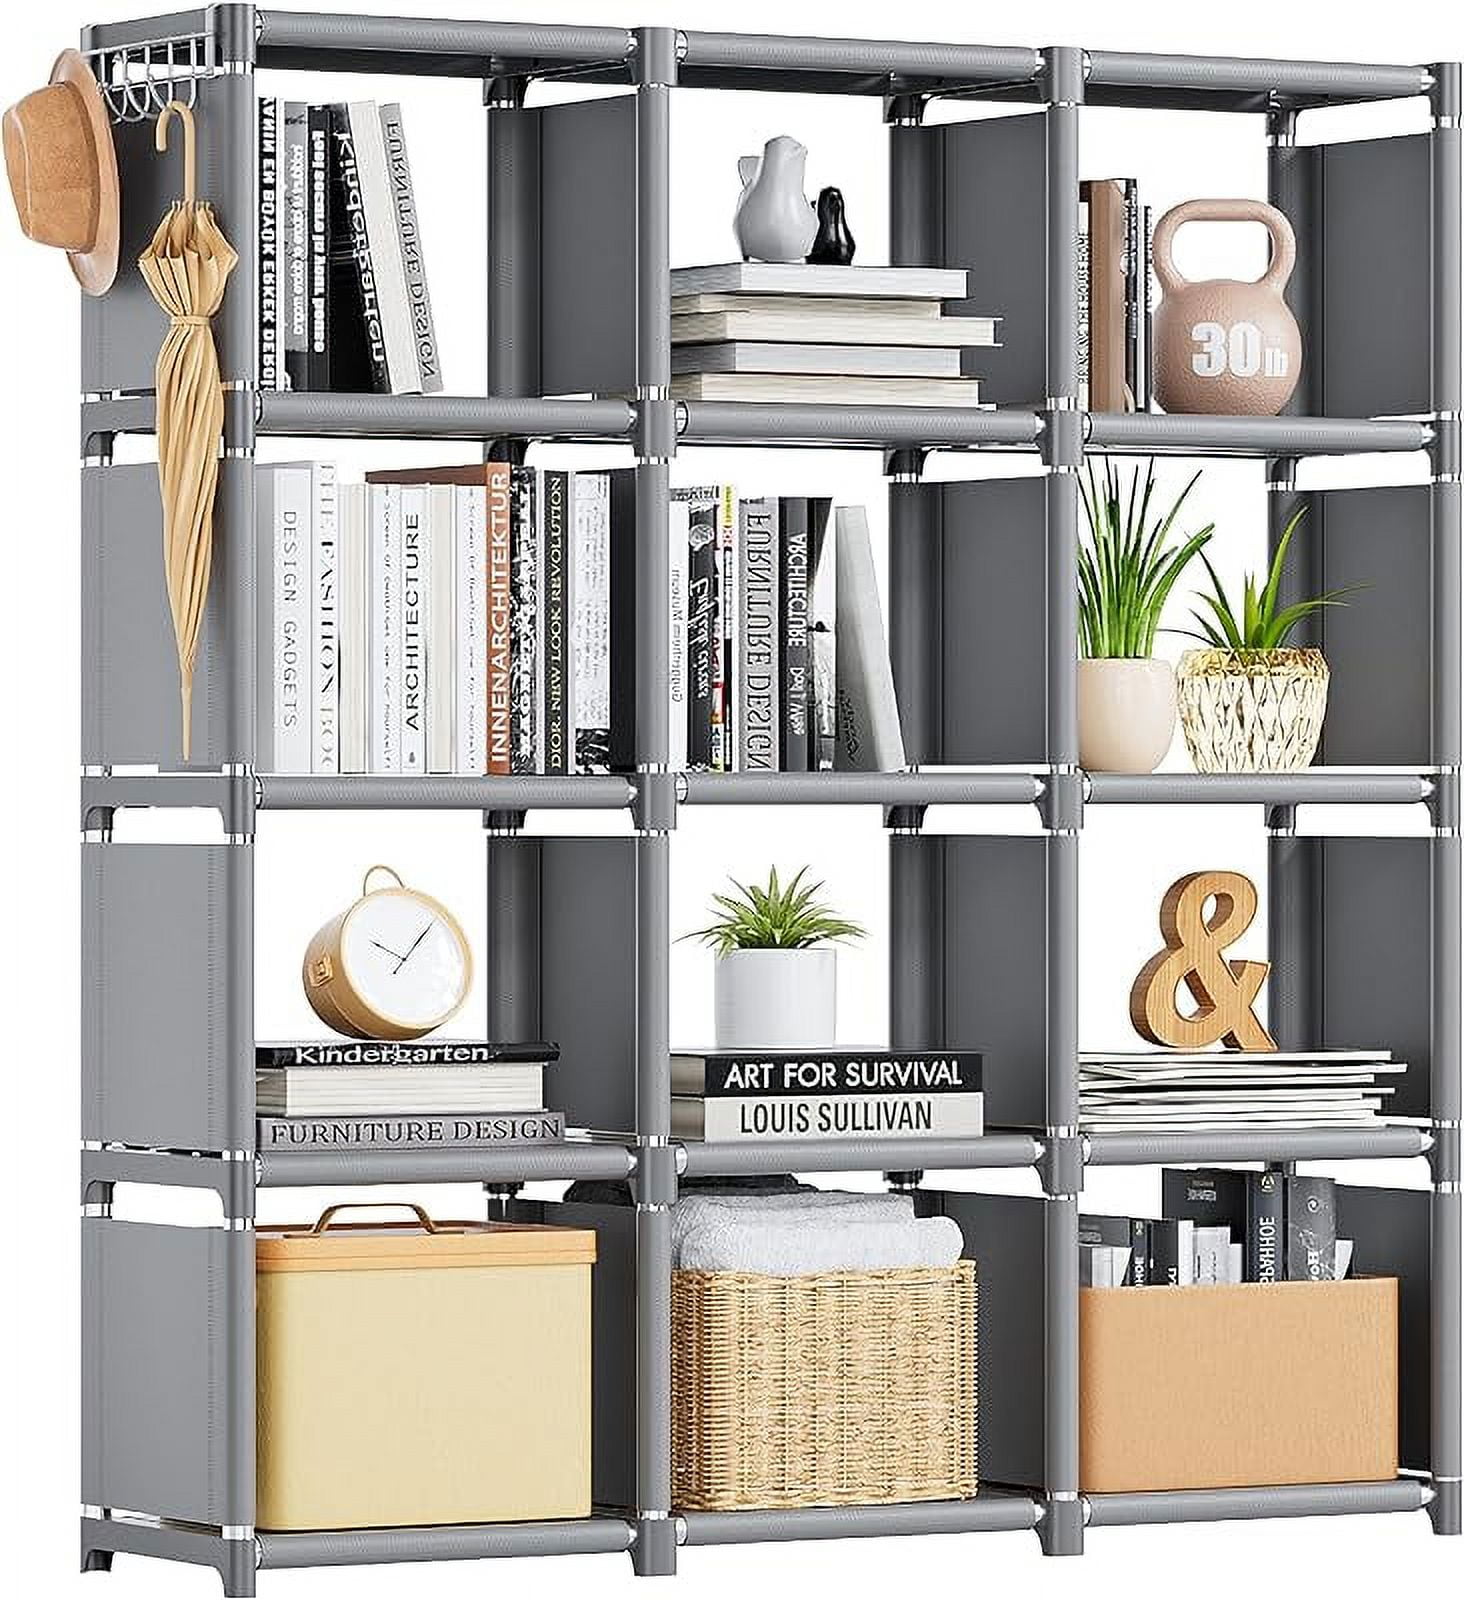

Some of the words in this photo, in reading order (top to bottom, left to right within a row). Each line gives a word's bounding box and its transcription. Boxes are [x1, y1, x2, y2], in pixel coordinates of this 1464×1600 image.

[283, 511, 297, 602] DESIGN
[550, 477, 562, 602] REVOLUTION
[405, 513, 419, 732] ARCHITECTURE
[491, 472, 510, 762] INNENARCHITEKTUR
[550, 607, 562, 662] LOOK
[283, 620, 297, 728] GADGETS
[550, 665, 562, 711] NEW
[295, 1044, 489, 1065] Kindergarten
[723, 1062, 773, 1089] ART
[783, 1061, 837, 1088] FOR
[845, 1060, 963, 1087] SURVIVAL
[271, 1119, 444, 1144] FURNITURE
[453, 1117, 561, 1140] DESIGN
[740, 1102, 810, 1134] LOUIS
[818, 1100, 933, 1132] SULLIVAN
